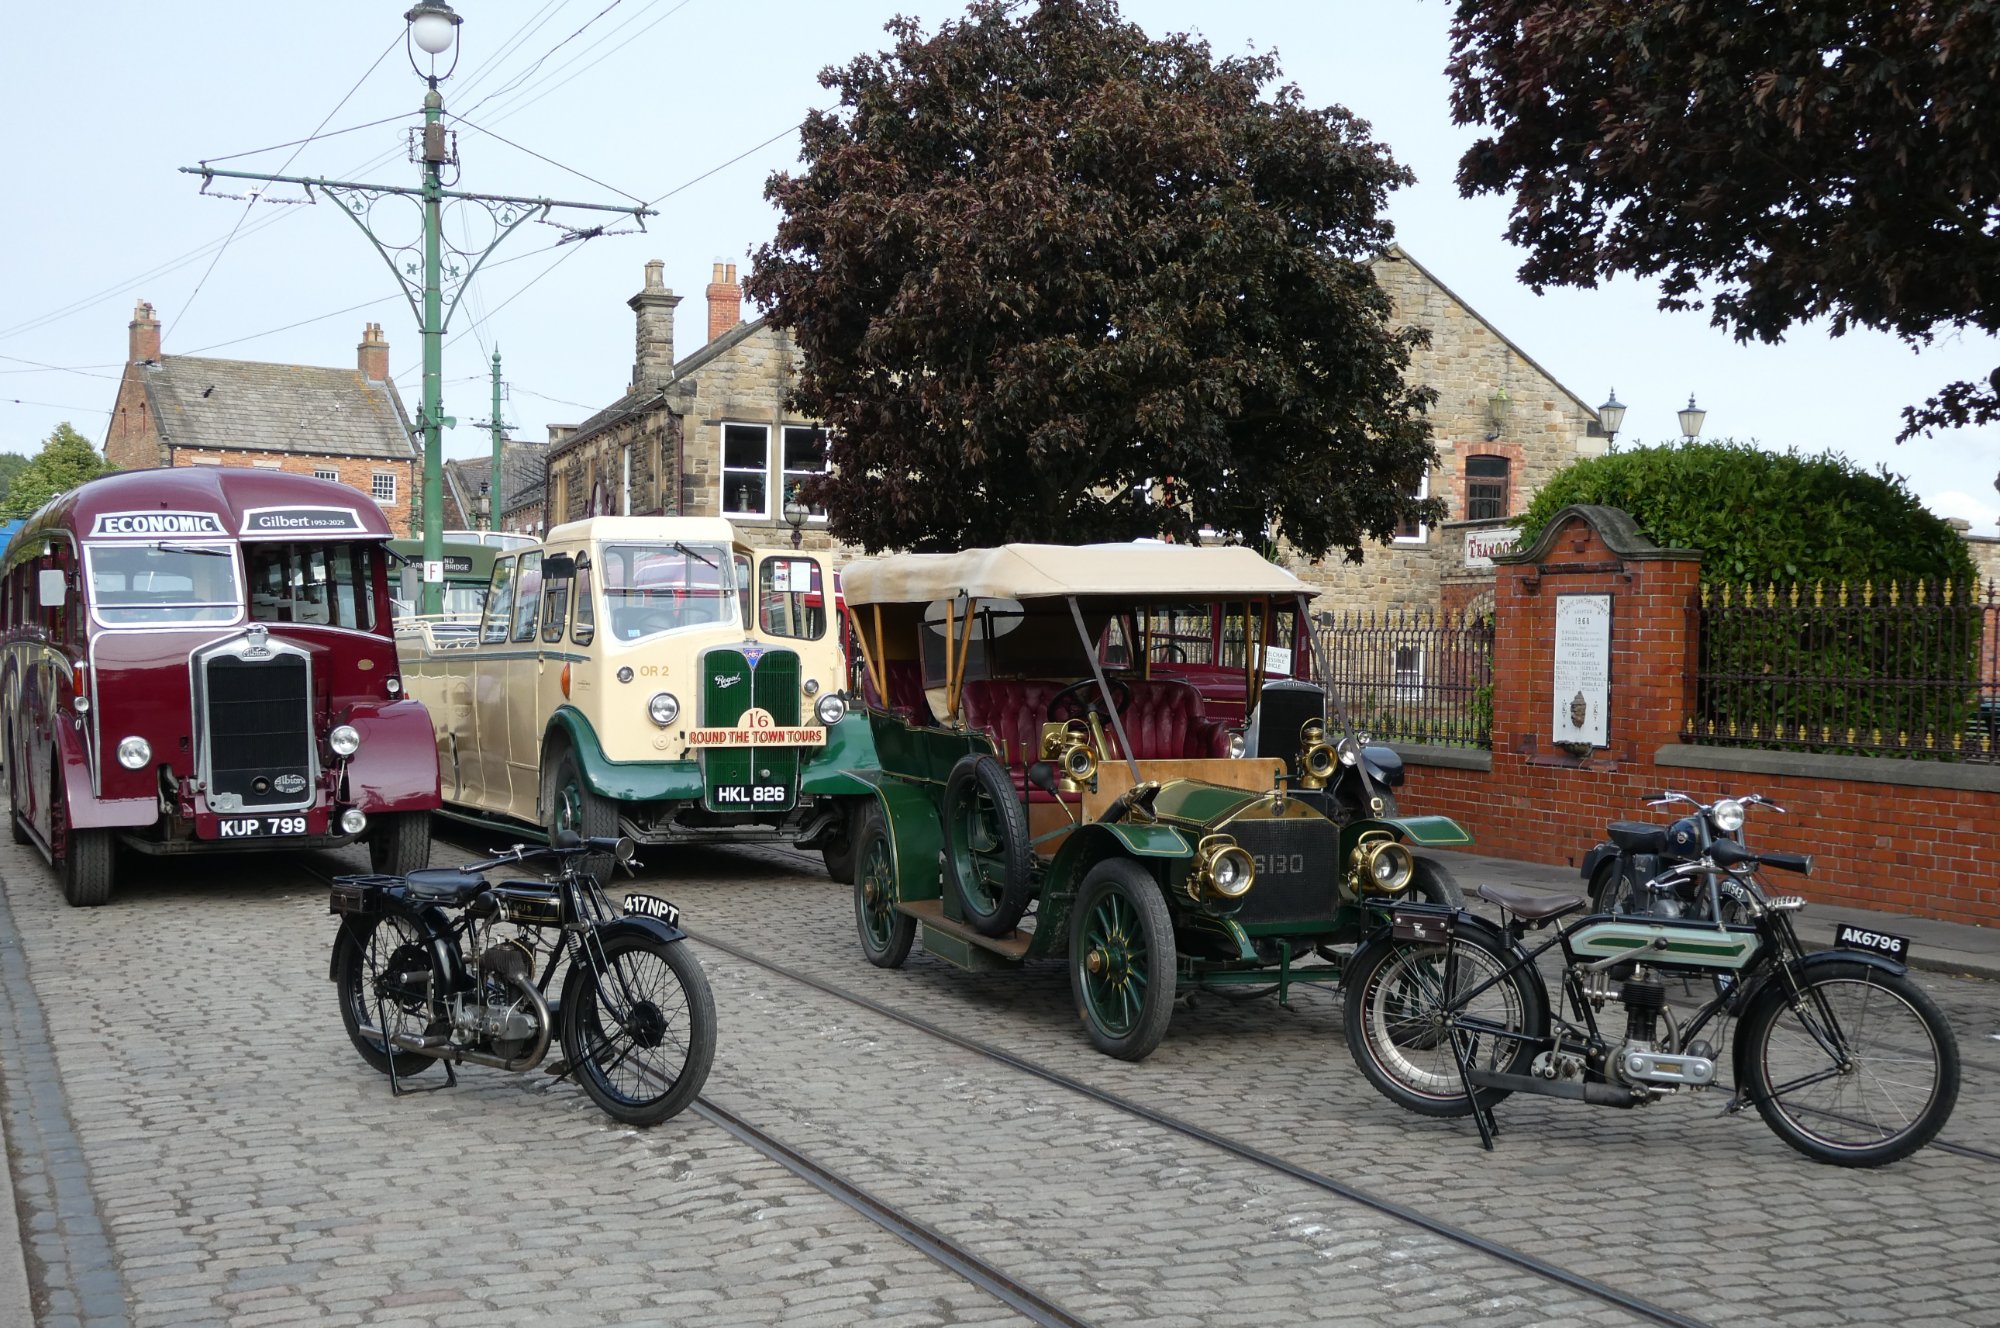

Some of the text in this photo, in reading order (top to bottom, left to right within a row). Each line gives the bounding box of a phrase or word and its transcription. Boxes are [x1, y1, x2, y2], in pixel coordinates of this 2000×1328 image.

[104, 515, 213, 533] ECONOMIC
[259, 516, 346, 528] Gilbert 1952-2025
[429, 563, 438, 580] F
[444, 563, 469, 571] BRIDGE
[639, 665, 670, 677] OR 2
[714, 672, 741, 689] Regal
[689, 730, 822, 745] ROUND THE TOWN TOURS
[718, 786, 785, 802] HKL 826
[221, 817, 306, 837] KUP 799
[1841, 927, 1902, 952] AK6796
